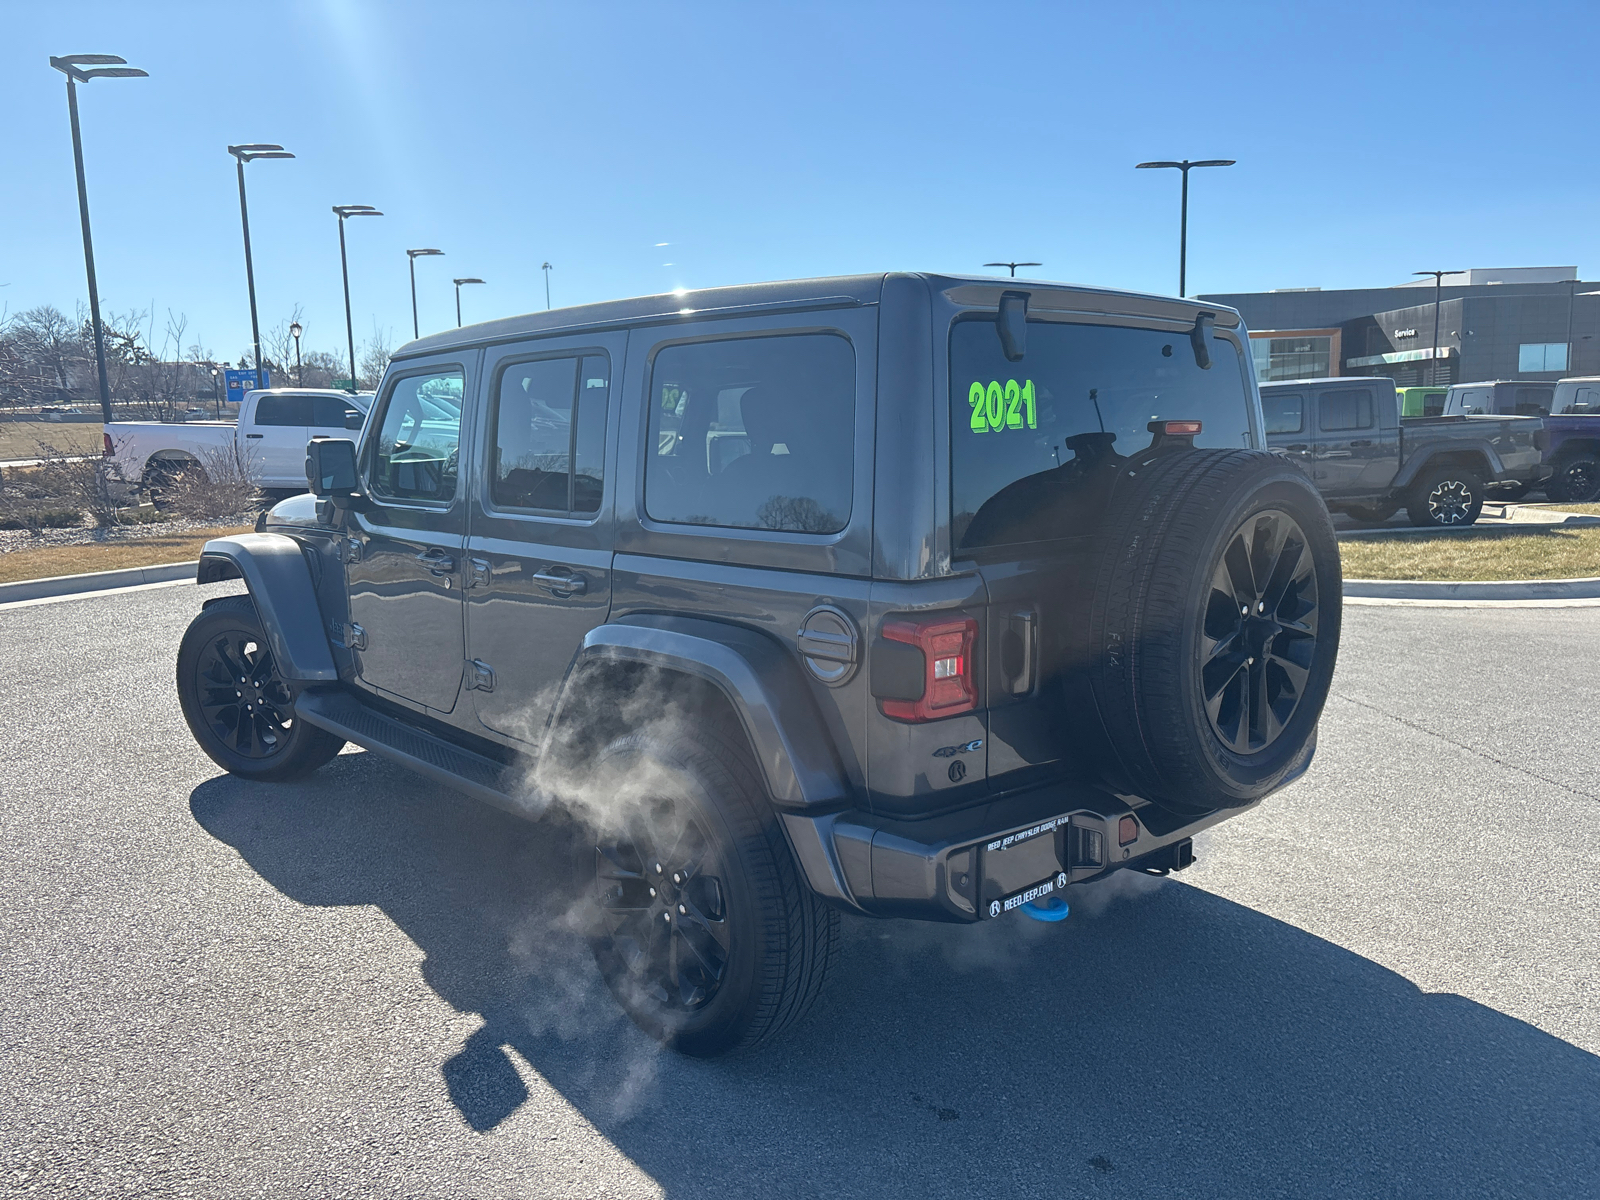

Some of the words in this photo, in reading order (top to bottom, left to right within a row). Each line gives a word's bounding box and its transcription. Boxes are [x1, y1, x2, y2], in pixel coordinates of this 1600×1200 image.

[1394, 327, 1416, 338] Service
[969, 379, 1037, 433] 2021
[987, 840, 1001, 852] REED
[1002, 834, 1015, 848] JEEP
[1014, 826, 1040, 842] CHRYSLER
[1040, 819, 1057, 833] DODGE
[1057, 815, 1069, 826] RAM
[1004, 881, 1054, 912] REEDJEEP.COM
